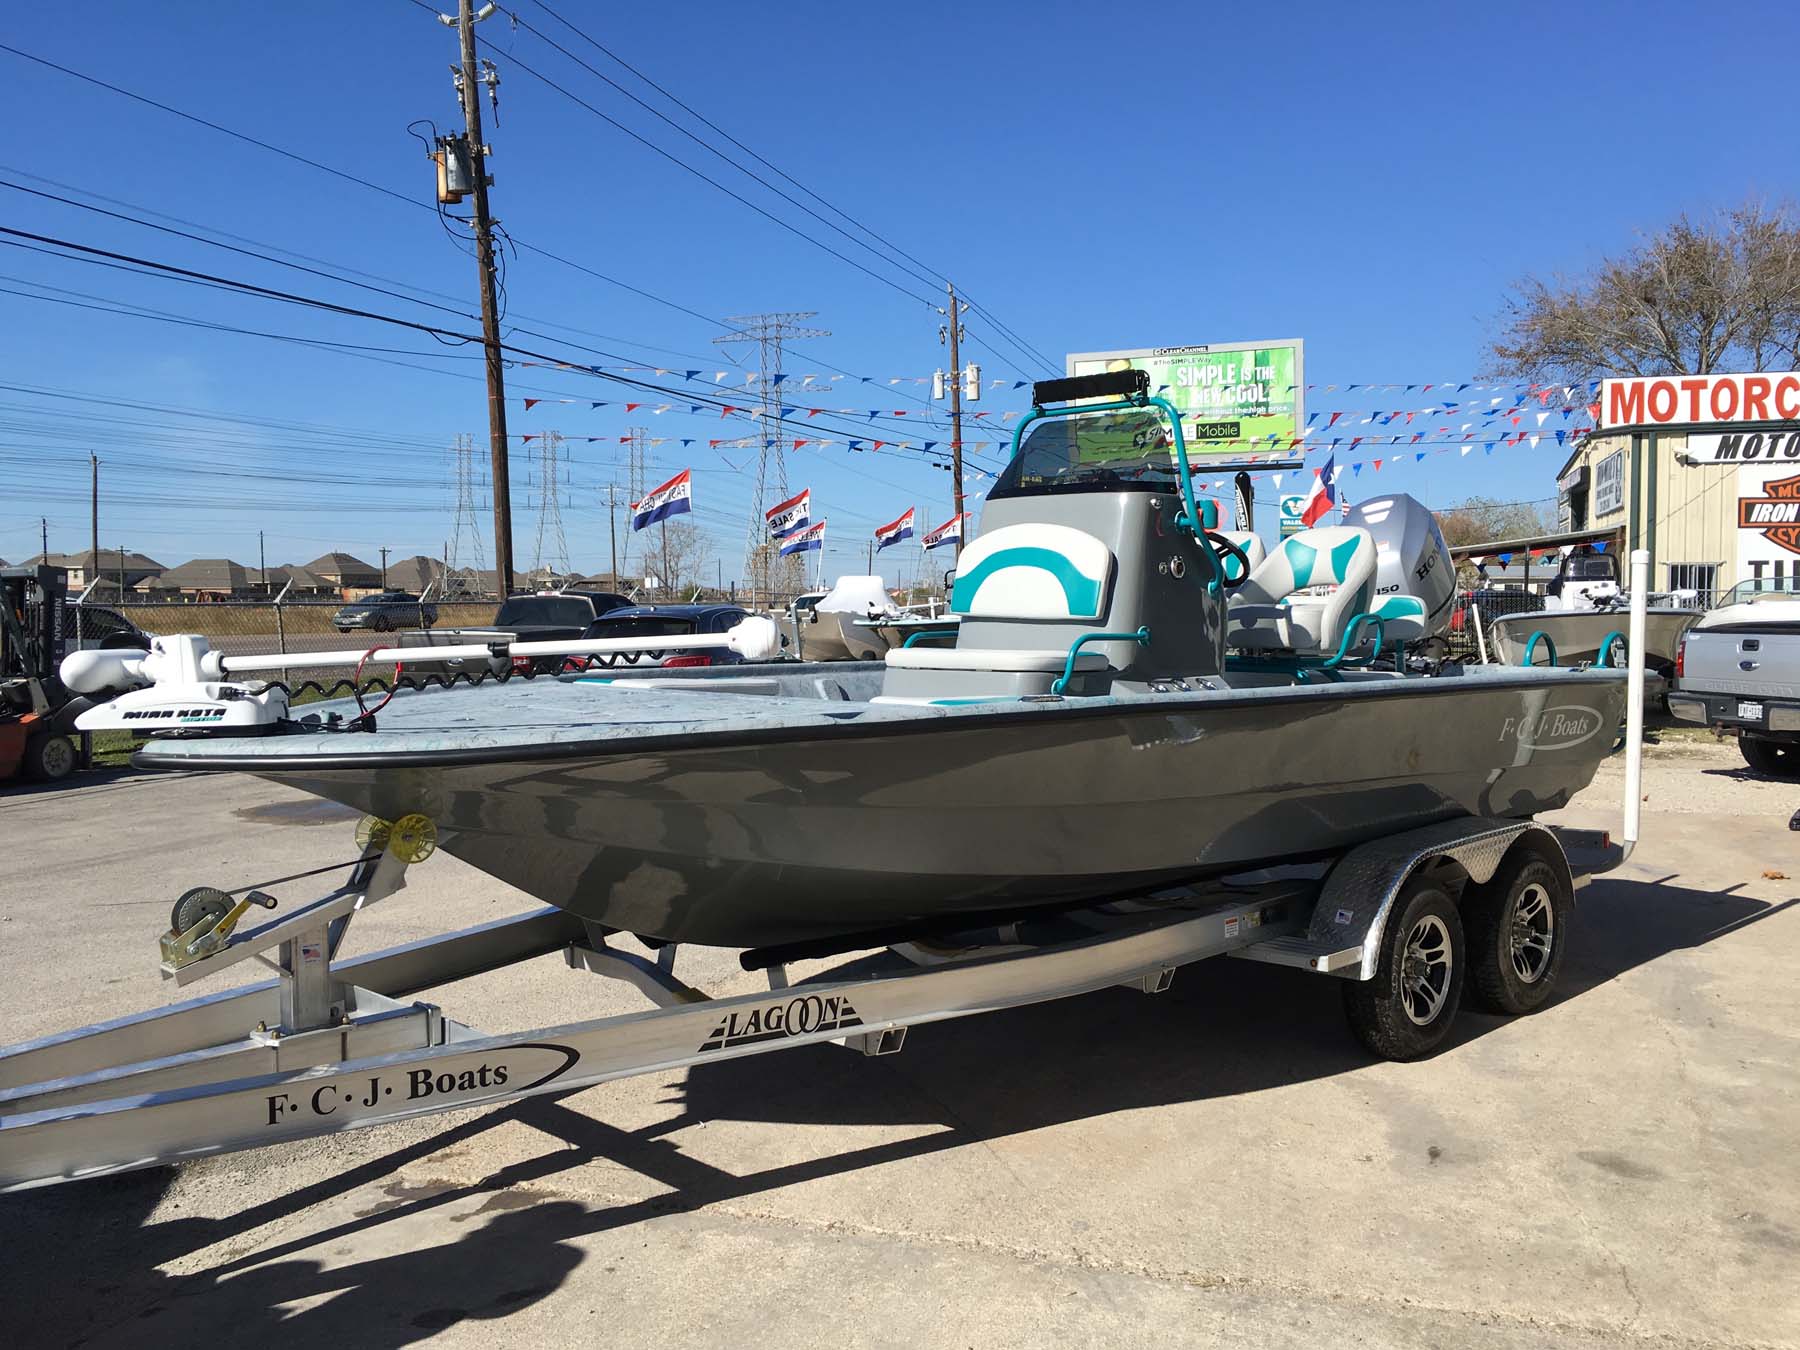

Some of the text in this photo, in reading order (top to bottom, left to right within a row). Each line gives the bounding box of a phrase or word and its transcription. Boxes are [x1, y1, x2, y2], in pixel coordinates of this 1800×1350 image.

[1177, 364, 1275, 387] SIMPLE IS THE
[1198, 423, 1238, 438] Mobile
[1749, 503, 1799, 523] IRON
[1376, 584, 1400, 596] 150
[54, 597, 63, 641] NISSAN
[1550, 714, 1589, 738] Boats
[727, 995, 842, 1038] LAGOON
[406, 1063, 508, 1101] Boats
